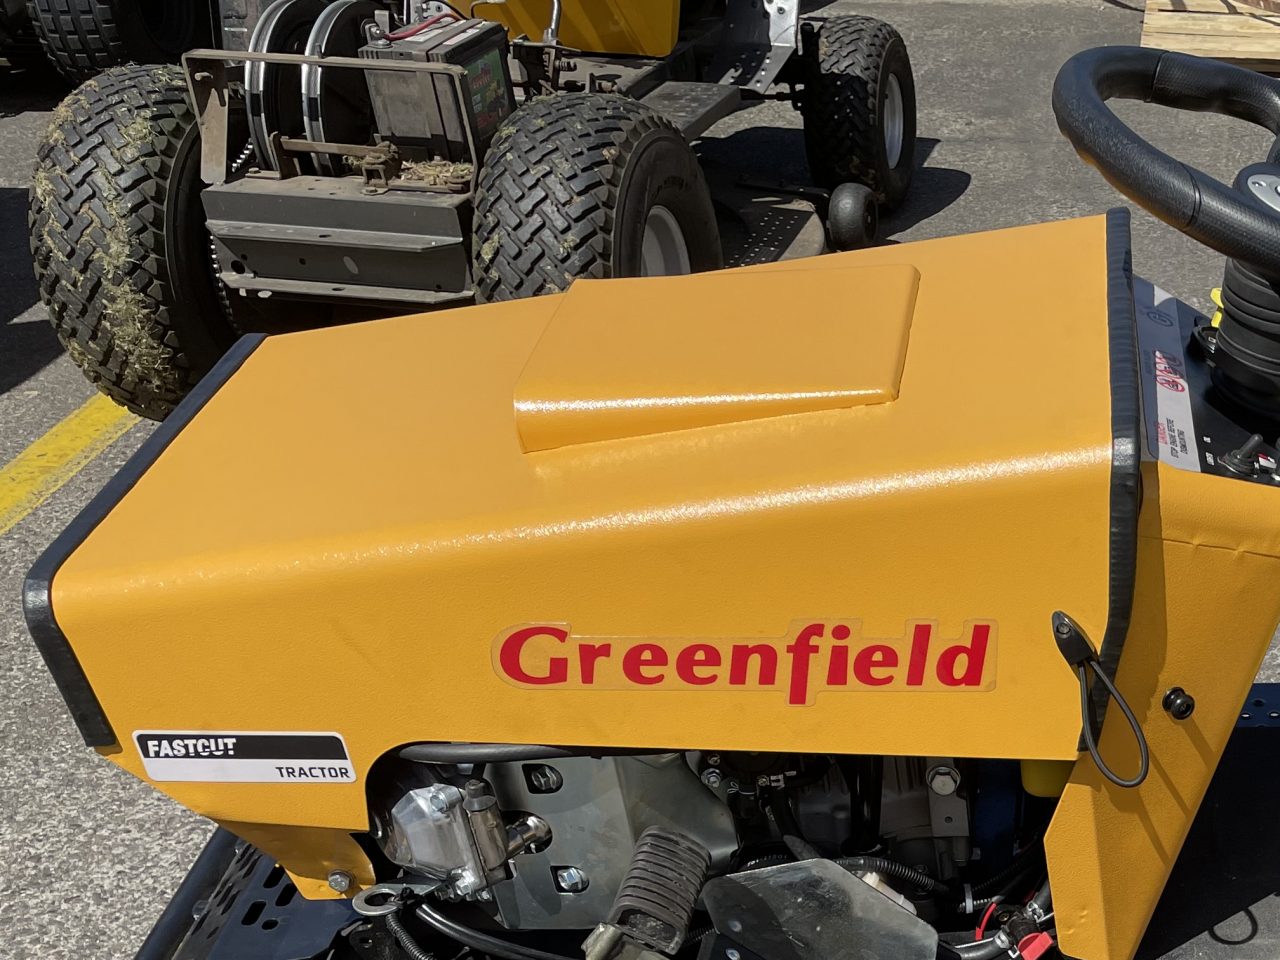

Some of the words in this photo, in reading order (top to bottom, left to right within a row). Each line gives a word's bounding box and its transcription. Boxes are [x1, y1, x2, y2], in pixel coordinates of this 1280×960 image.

[499, 623, 990, 705] Greenfield
[147, 737, 237, 757] FASTCUT
[275, 766, 350, 778] TRACTOR
